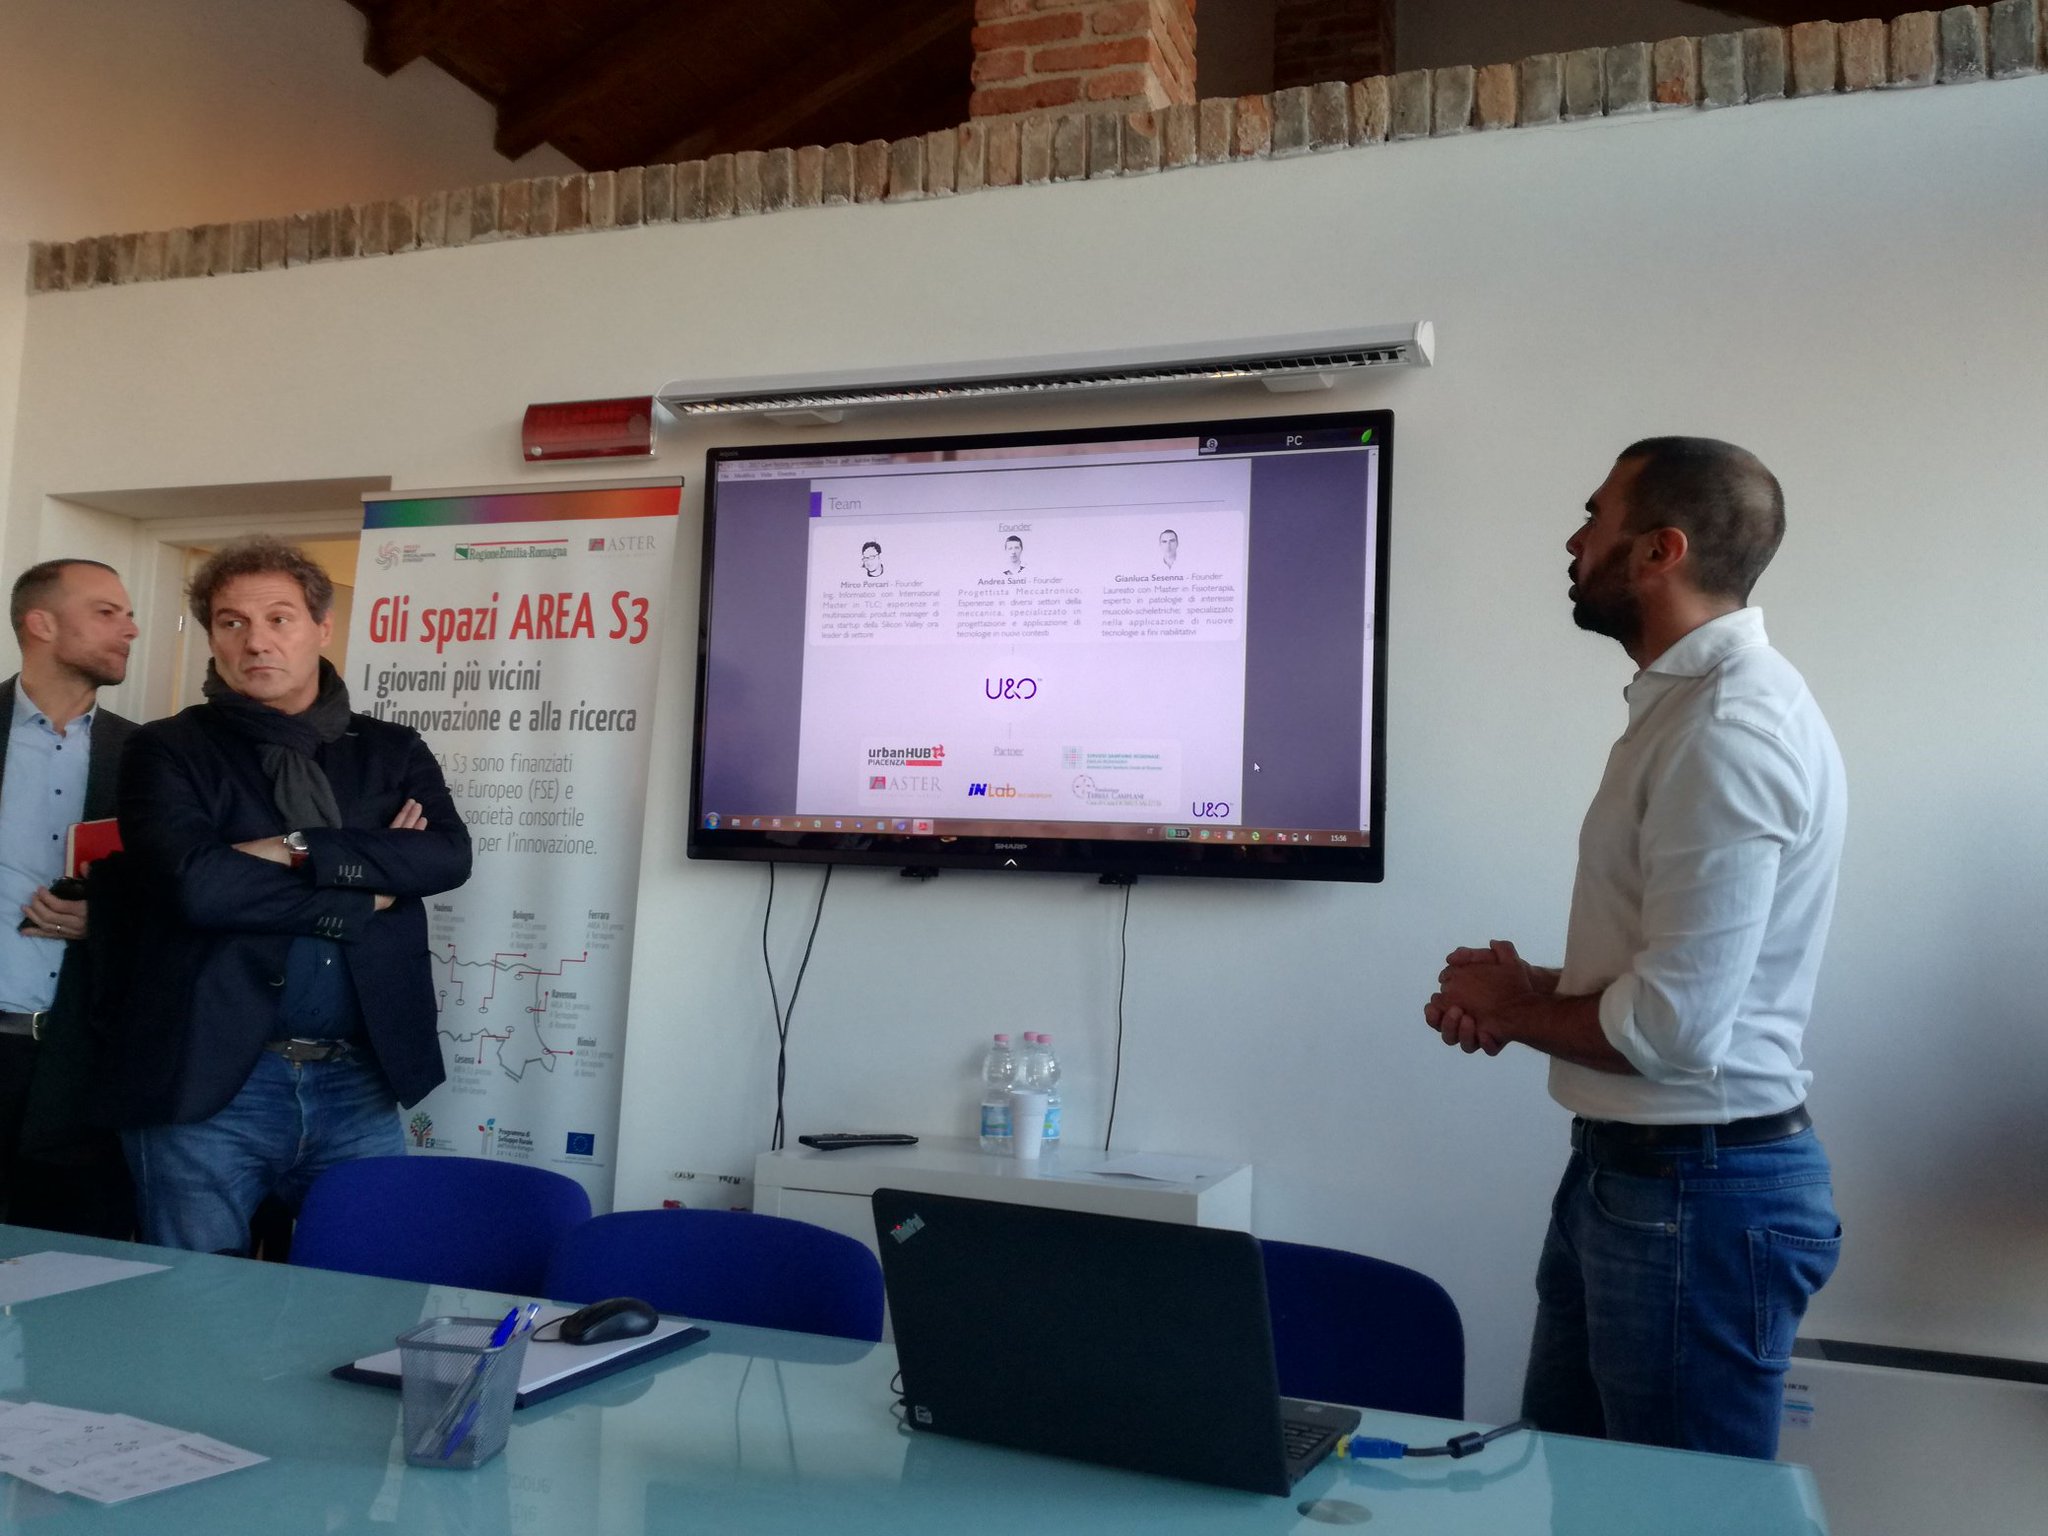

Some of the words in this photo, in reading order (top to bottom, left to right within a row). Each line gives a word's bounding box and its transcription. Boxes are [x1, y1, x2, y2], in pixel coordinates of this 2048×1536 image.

[1287, 435, 1303, 446] PC
[828, 498, 862, 510] Team
[998, 523, 1032, 532] Founder
[608, 536, 656, 551] ASTER
[1152, 574, 1184, 582] Sesenna
[958, 589, 1009, 598] Progettista
[1104, 586, 1135, 594] Laureato
[958, 600, 994, 608] Esperienze
[1103, 597, 1131, 605] esperto
[1149, 596, 1183, 605] patologie
[1010, 609, 1067, 617] specializzato
[1187, 606, 1234, 614] specializzato
[870, 611, 896, 620] product
[900, 611, 928, 619] manager
[369, 594, 410, 644] Gli
[419, 591, 500, 654] spazi
[509, 591, 596, 641] AREA
[609, 590, 649, 645] S3
[837, 622, 859, 630] startup
[905, 621, 924, 629] Valley
[957, 621, 1006, 629] progettazione
[1023, 619, 1068, 628] applicazione
[1129, 618, 1184, 626] applicazione
[957, 630, 991, 639] tecnologie
[1102, 629, 1138, 638] tecnologie
[363, 663, 371, 691] I
[376, 662, 447, 699] giovani
[452, 660, 480, 699] più
[488, 660, 542, 691] vicini
[509, 708, 521, 731] e
[529, 700, 561, 731] alla
[569, 700, 637, 731] ricerca
[868, 747, 931, 759] urbanHUB
[993, 746, 1024, 756] Partner
[452, 754, 467, 773] S3
[471, 755, 505, 773] sono
[510, 753, 573, 773] finanziati
[890, 776, 942, 791] ASTER
[467, 779, 522, 802] Europeo
[528, 778, 560, 804] (FSE)
[565, 784, 573, 800] e
[464, 805, 513, 826] società
[518, 807, 585, 827] consortile
[478, 835, 502, 856] per
[507, 831, 598, 855] l'innovazione.
[588, 910, 610, 920] Ferrara
